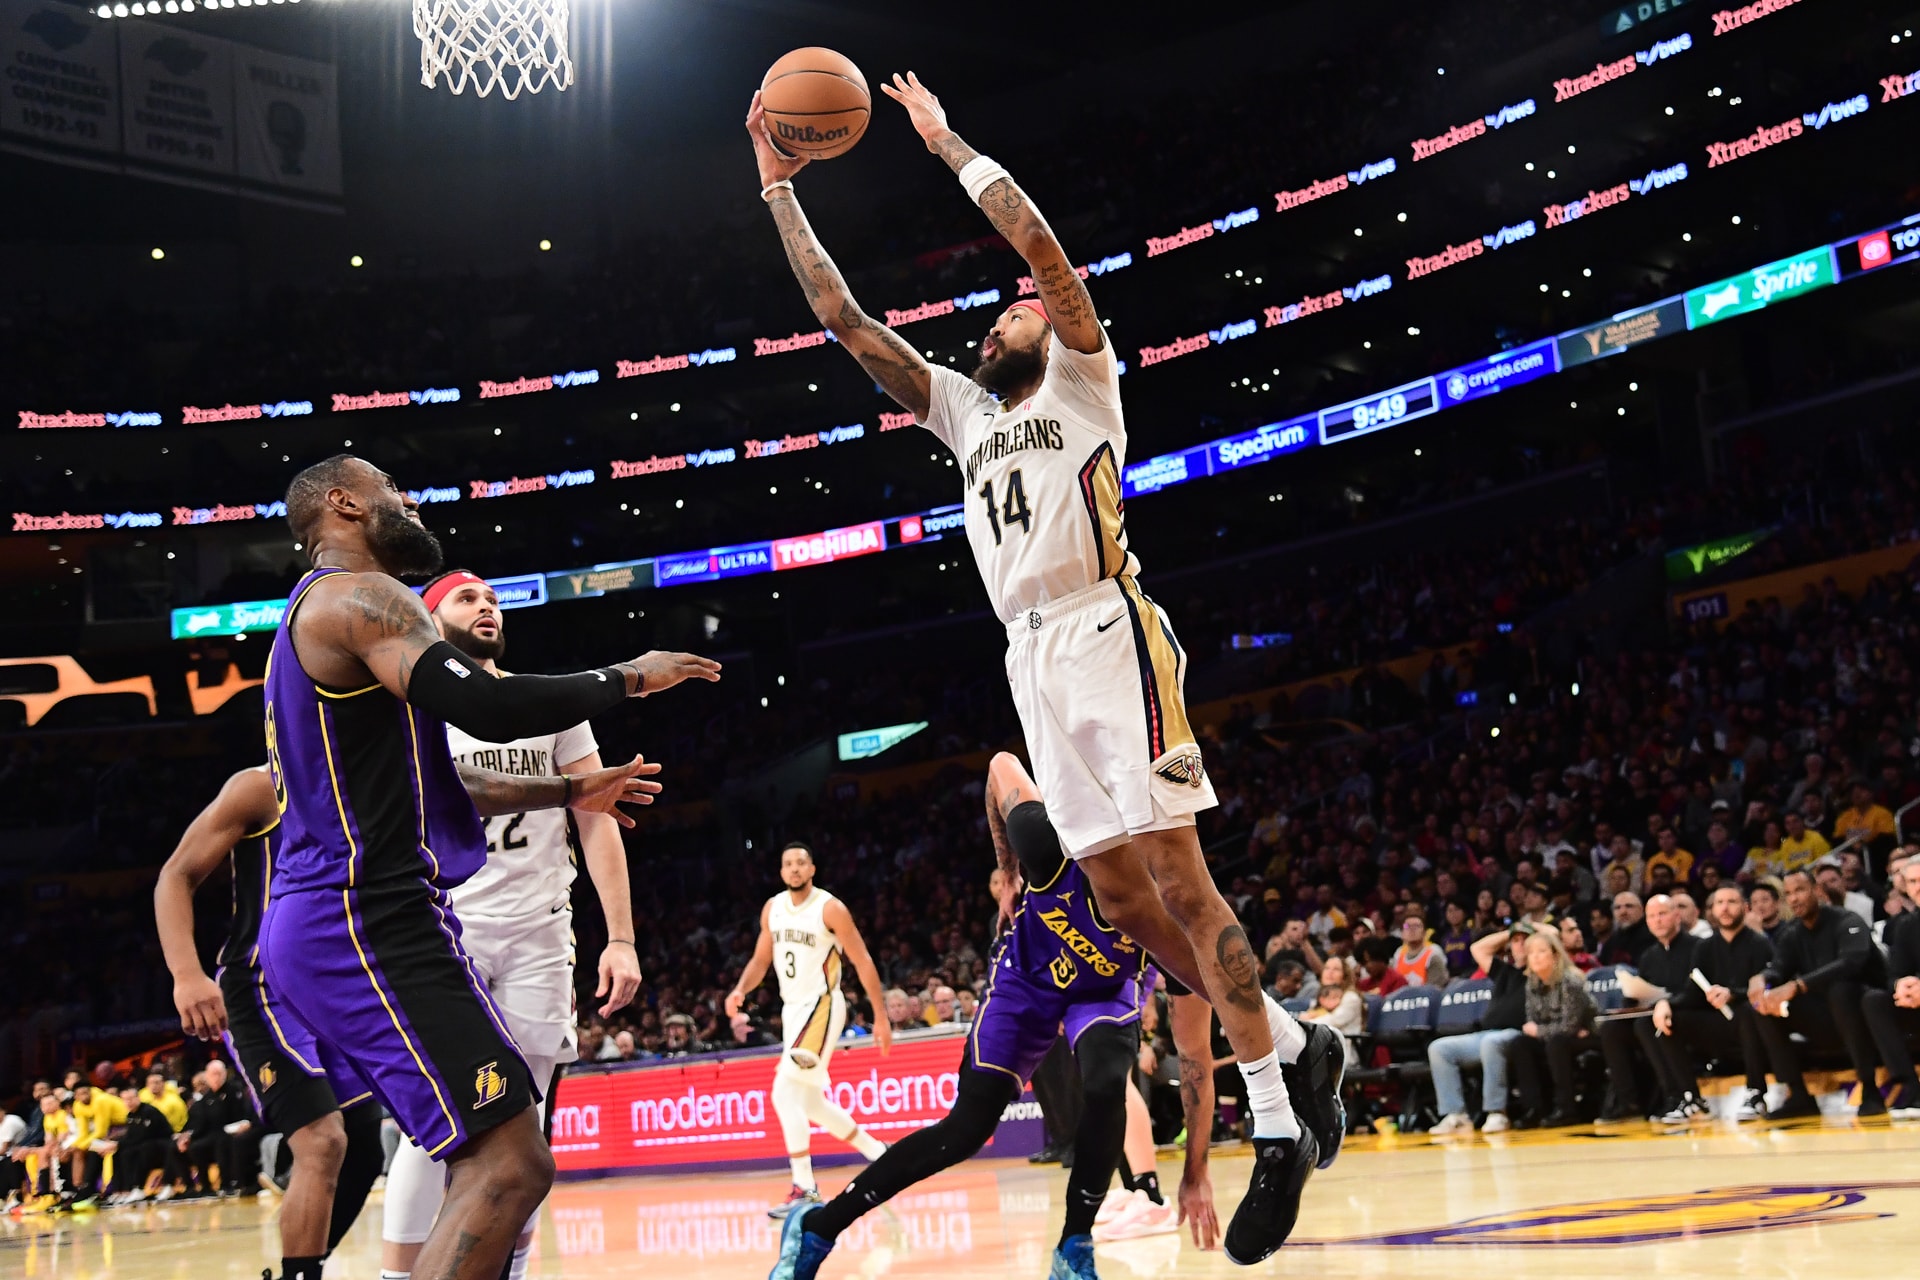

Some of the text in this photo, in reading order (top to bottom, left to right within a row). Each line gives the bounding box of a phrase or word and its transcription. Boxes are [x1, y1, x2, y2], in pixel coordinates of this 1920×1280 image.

[1554, 56, 1636, 102] Xtrackers
[776, 120, 849, 143] Wilson
[1412, 119, 1486, 161] Xtrackers
[1706, 118, 1803, 168] Xtrackers
[1275, 175, 1348, 212] Xtrackers
[1544, 184, 1629, 228] Xtrackers
[1147, 223, 1214, 257] Xtrackers
[1406, 239, 1483, 280] Xtrackers
[1752, 259, 1818, 301] Sprite
[885, 300, 954, 328] Xtrackers
[1264, 291, 1343, 327] Xtrackers
[754, 331, 826, 356] Xtrackers
[1140, 334, 1209, 367] Xtrackers
[617, 355, 689, 378] Xtrackers
[1468, 353, 1544, 388] crypto.com
[332, 391, 410, 411] Xtrackers
[480, 377, 553, 398] Xtrackers
[19, 410, 106, 428] Xtrackers
[183, 404, 262, 424] Xtrackers
[1352, 393, 1407, 430] 9:49
[745, 434, 819, 458] Xtrackers
[986, 418, 1064, 463] ORLEANS
[1218, 425, 1304, 466] Spectrum
[611, 455, 686, 479] Xtrackers
[1125, 455, 1187, 483] AMERICAN
[470, 477, 546, 498] Xtrackers
[13, 512, 104, 531] Xtrackers
[173, 504, 255, 525] Xtrackers
[979, 467, 1032, 548] 14
[923, 513, 965, 532] TOYOT
[719, 550, 768, 570] ULTRA
[778, 528, 879, 565] TOSHIBA
[1686, 598, 1721, 620] 101
[1037, 907, 1120, 977] LAKERS
[785, 951, 796, 979] 3
[1392, 997, 1429, 1011] DELTA
[1453, 990, 1492, 1005] DELTA
[631, 1086, 765, 1132] moderna
